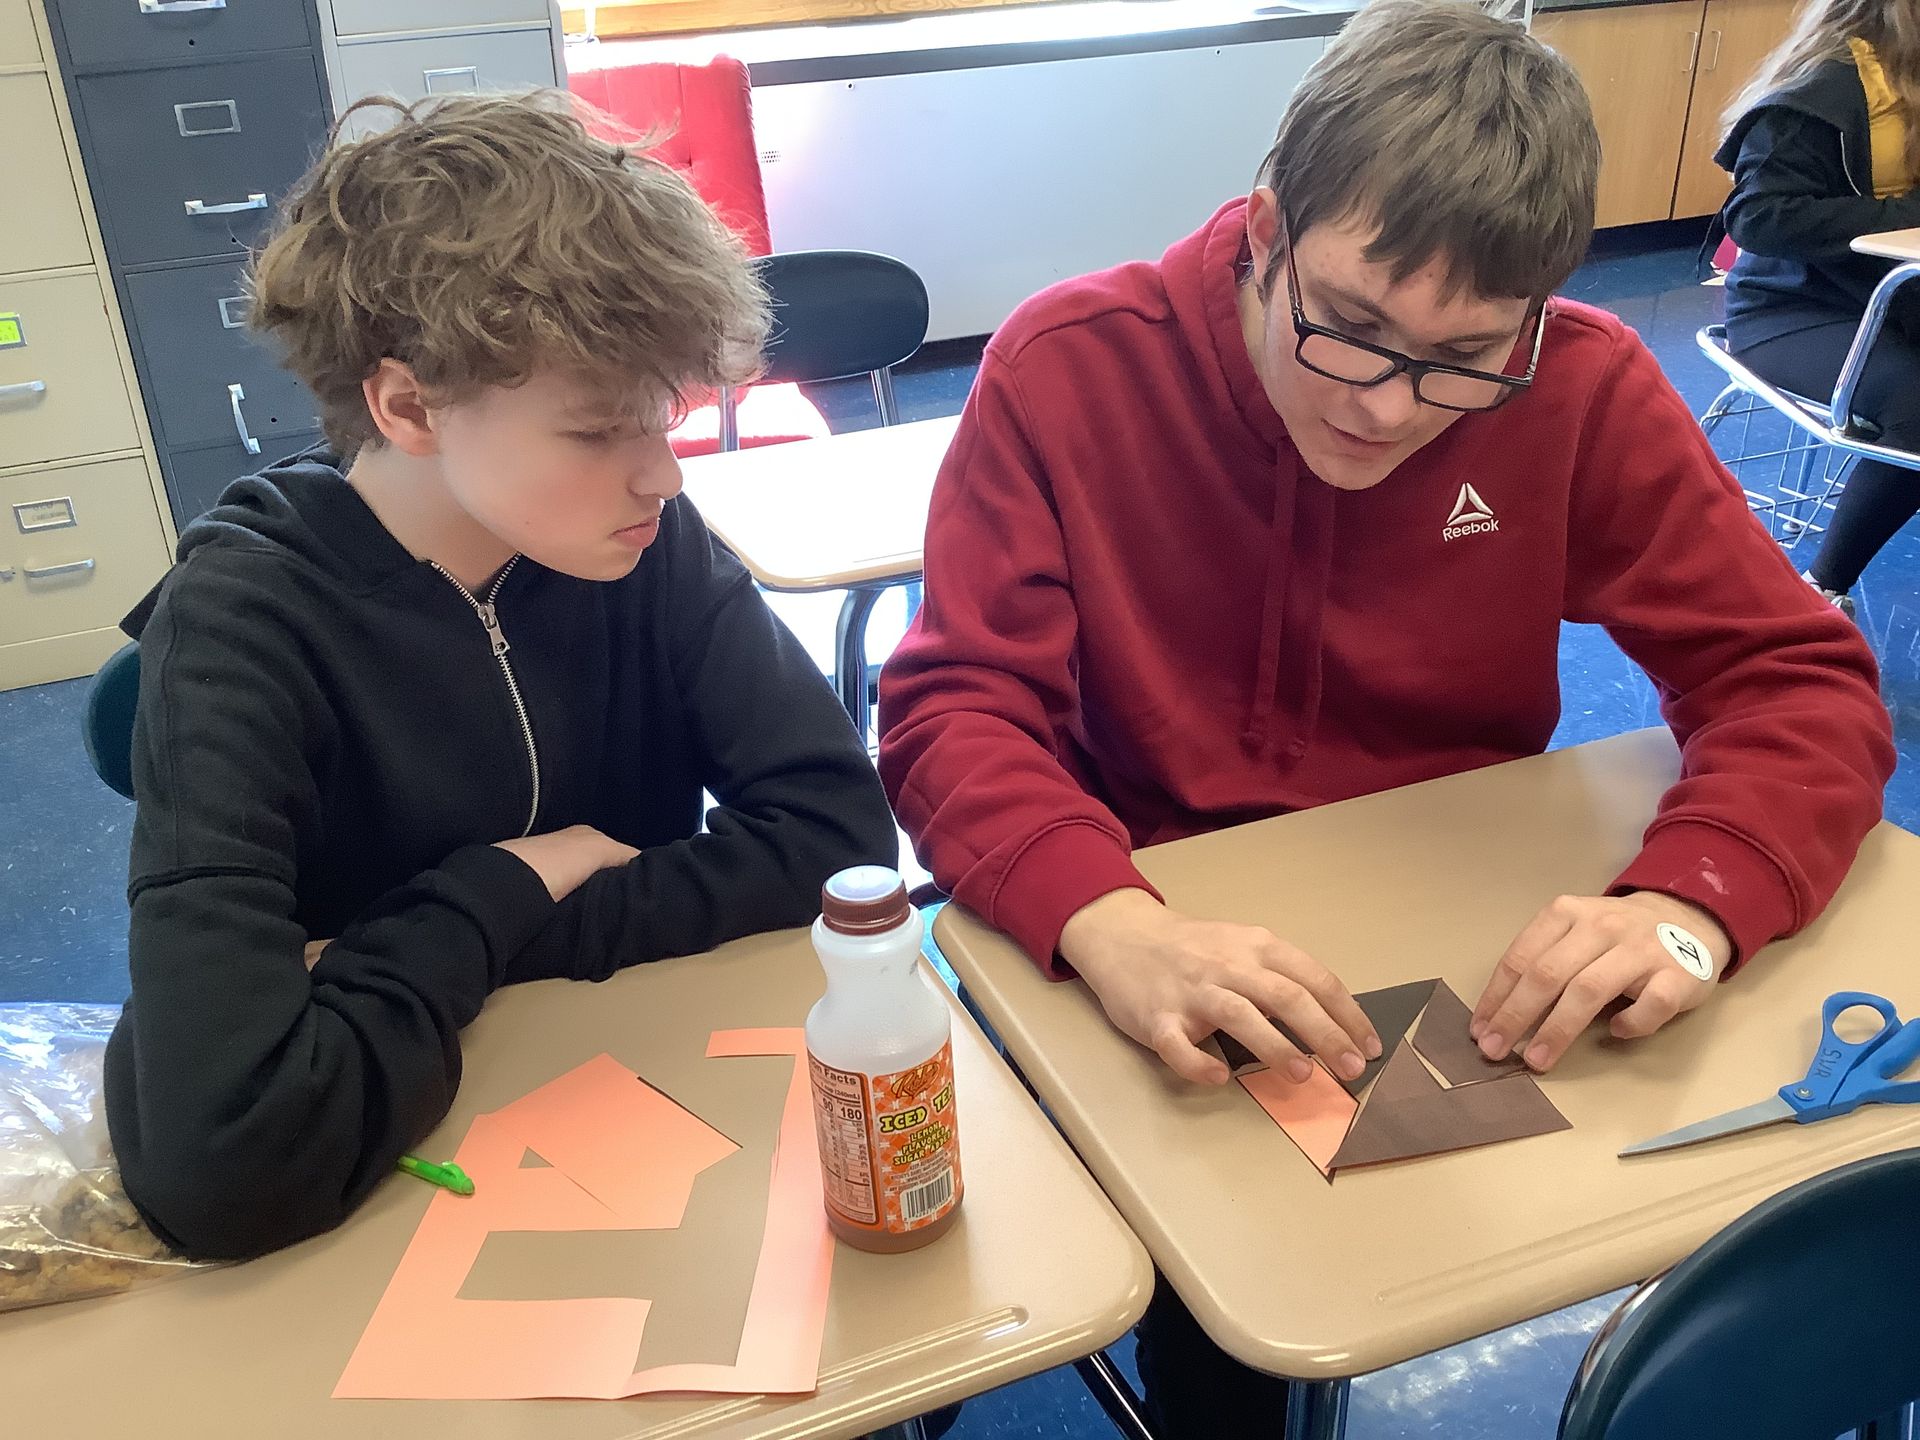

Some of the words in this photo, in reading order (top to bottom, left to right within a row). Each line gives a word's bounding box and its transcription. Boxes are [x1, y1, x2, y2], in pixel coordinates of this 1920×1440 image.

[1443, 519, 1499, 541] Reebok
[824, 1068, 857, 1085] Facts
[840, 1106, 863, 1120] 180
[880, 1106, 927, 1133] ICED
[910, 1121, 940, 1143] LEMON
[893, 1149, 926, 1166] SUGAR
